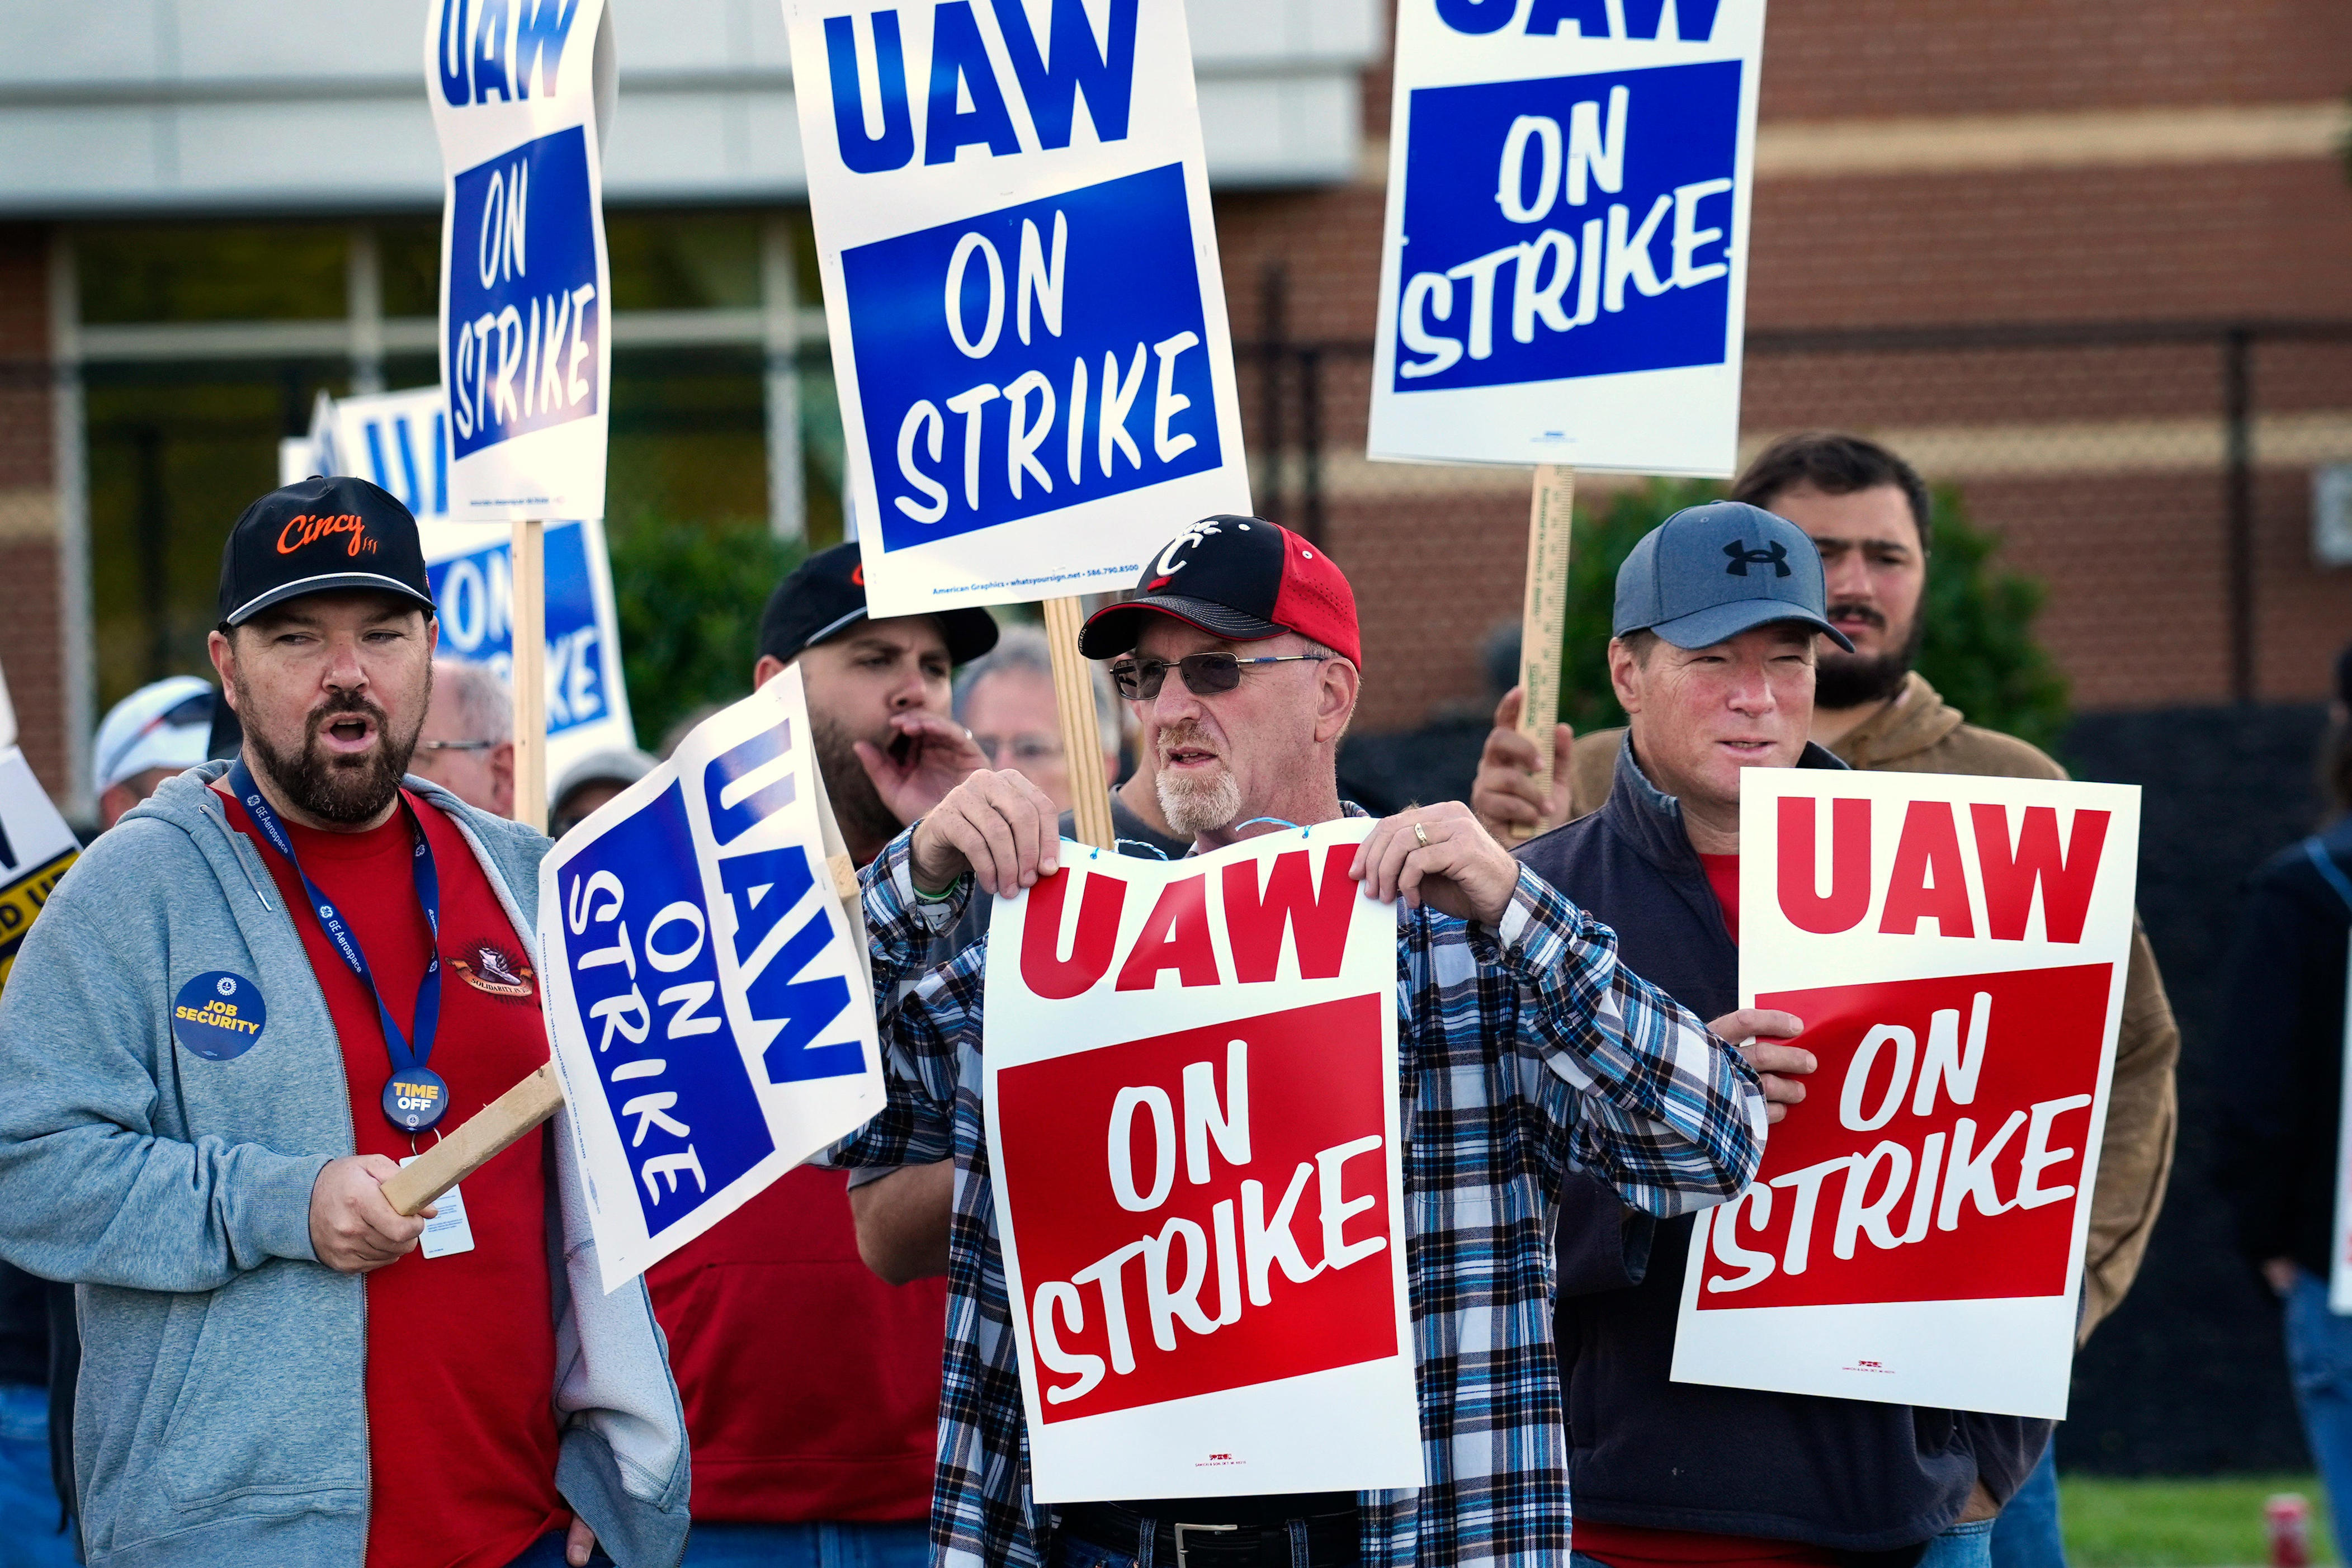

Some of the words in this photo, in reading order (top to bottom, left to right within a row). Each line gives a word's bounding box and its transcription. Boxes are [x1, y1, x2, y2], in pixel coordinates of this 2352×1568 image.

[439, 0, 578, 106] UAW
[823, 0, 1139, 174] UAW
[1495, 86, 1629, 223] ON
[480, 158, 527, 290] ON
[945, 210, 1068, 358] ON
[1400, 178, 1732, 379] STRIKE
[455, 282, 596, 440] STRIKE
[895, 331, 1199, 523] STRIKE
[277, 514, 365, 556] Cincy
[932, 585, 969, 595] American
[971, 581, 1005, 592] Graphics
[1010, 572, 1080, 587] whatsyoursign.net
[1087, 564, 1139, 577] 586.790.8500
[256, 806, 268, 818] GE
[261, 816, 289, 854] Aerospace
[1777, 796, 2112, 944] UAW
[328, 920, 341, 932] GE
[334, 932, 362, 972] Aerospace
[704, 718, 867, 1084] UAW
[1021, 843, 1361, 1000] UAW
[175, 1006, 259, 1035] SECURITY
[203, 1000, 238, 1017] JOB
[471, 979, 512, 993] SOLIDARITY
[569, 869, 706, 1207] STRIKE
[646, 901, 721, 1039] ON
[393, 1082, 439, 1099] TIME
[398, 1097, 432, 1111] OFF
[1108, 1040, 1251, 1212] ON
[1839, 991, 1992, 1132] ON
[1707, 1093, 2092, 1294] STRIKE
[1032, 1134, 1388, 1405] STRIKE
